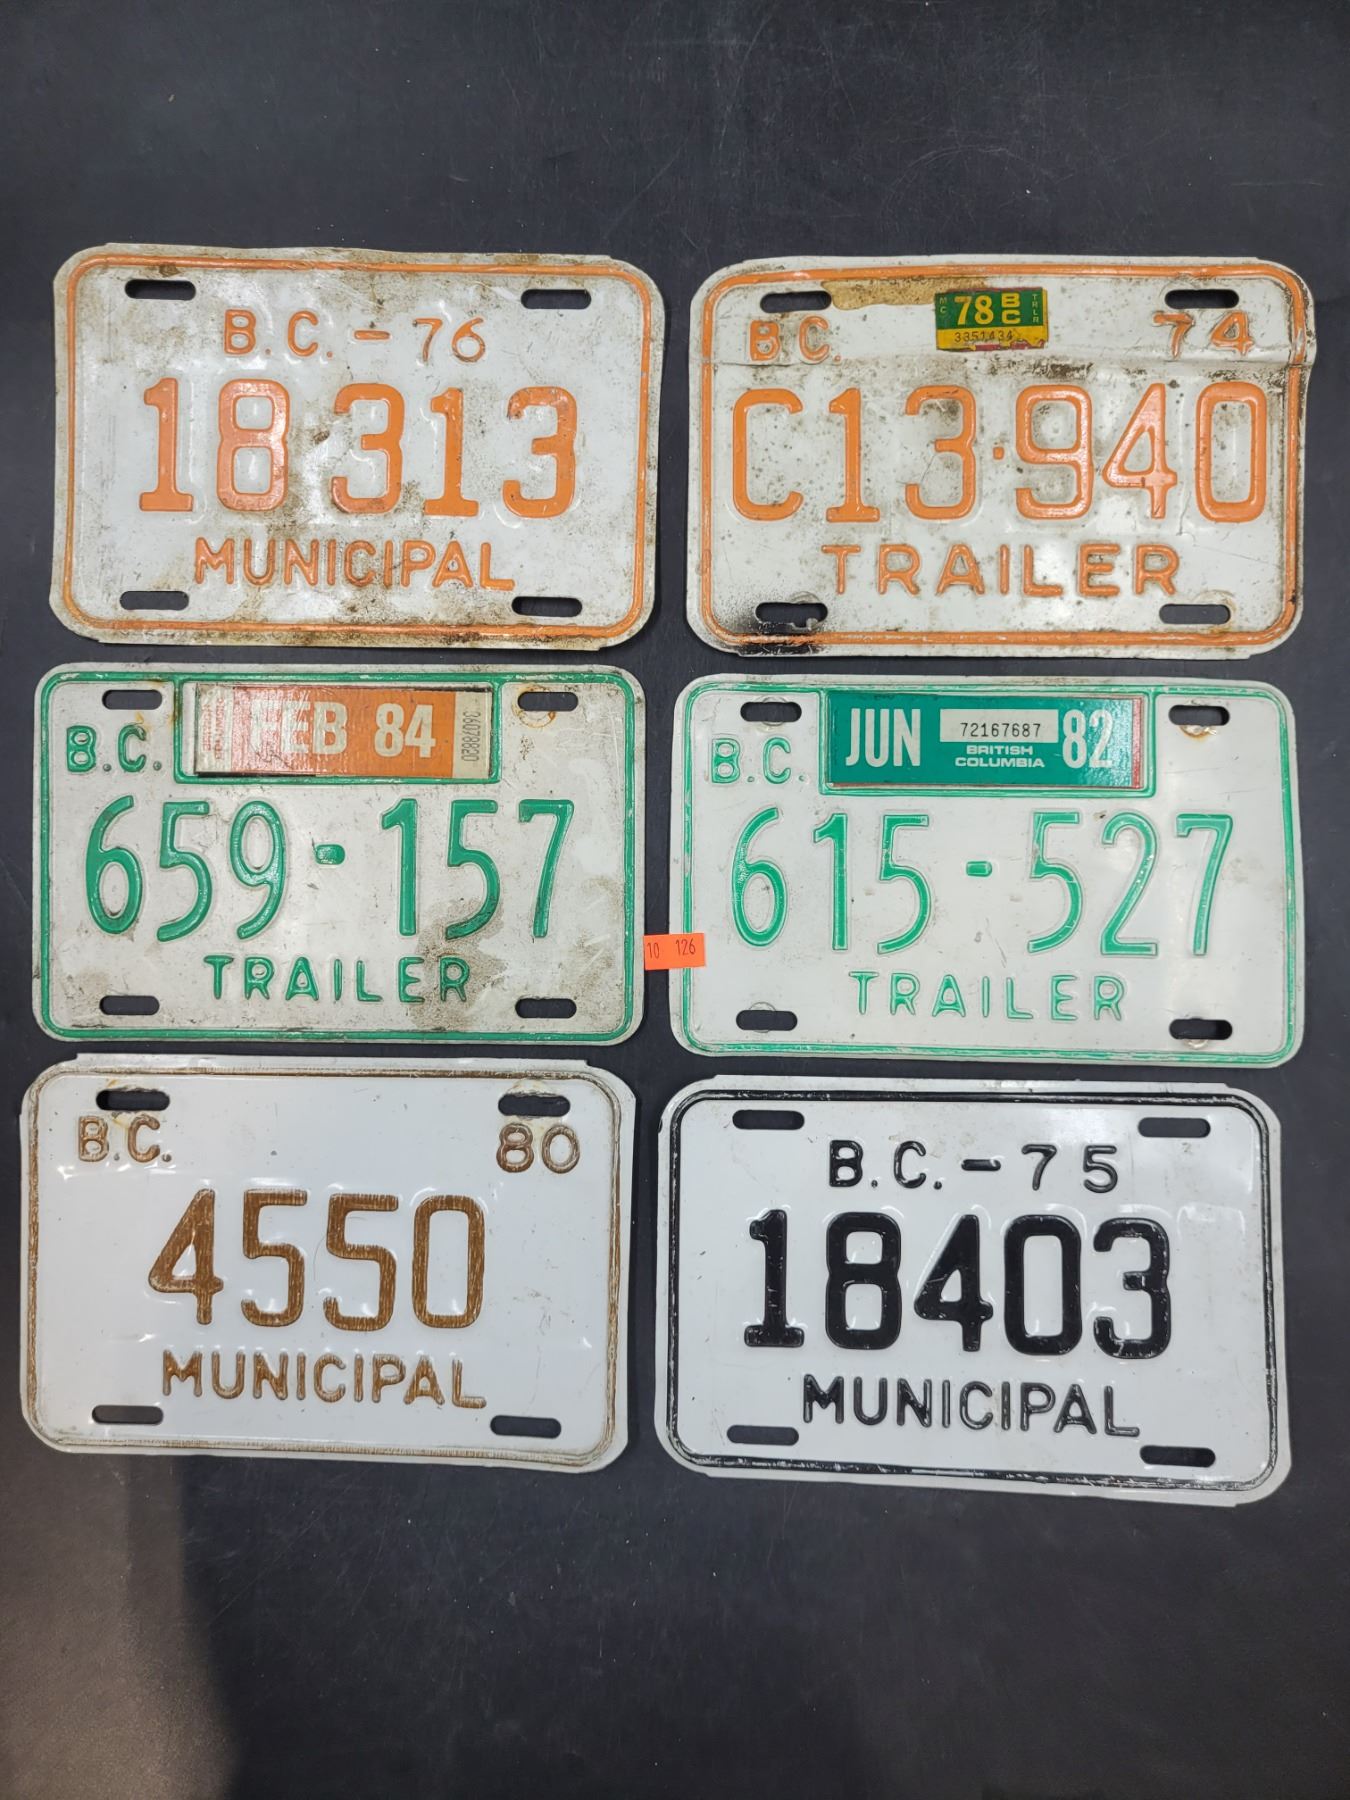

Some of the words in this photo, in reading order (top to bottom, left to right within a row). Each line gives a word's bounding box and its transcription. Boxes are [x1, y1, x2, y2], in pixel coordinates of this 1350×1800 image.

[954, 295, 994, 326] 78
[1152, 311, 1254, 358] 74
[194, 536, 515, 591] MUNICIPAL
[821, 542, 1181, 598] TRAILER
[65, 725, 162, 773] B.C.
[250, 699, 348, 755] FEB
[374, 702, 436, 758] 84
[845, 707, 922, 768] JUN
[959, 722, 1042, 738] 72167687
[966, 745, 1034, 756] BRITISH
[1062, 709, 1114, 769] 82
[710, 737, 807, 785] B.C.
[954, 756, 1046, 768] COLUMBIA
[646, 942, 660, 960] 10
[675, 937, 697, 956] 126
[203, 955, 471, 1002] TRAILER
[848, 971, 1125, 1022] TRAILER
[76, 1114, 173, 1164] B.C.
[496, 1121, 581, 1174] 80
[147, 1187, 486, 1332] 4550
[743, 1209, 1172, 1360] 18403
[161, 1348, 488, 1410] MUNICIPAL
[802, 1373, 1141, 1438] MUNICIPAL
